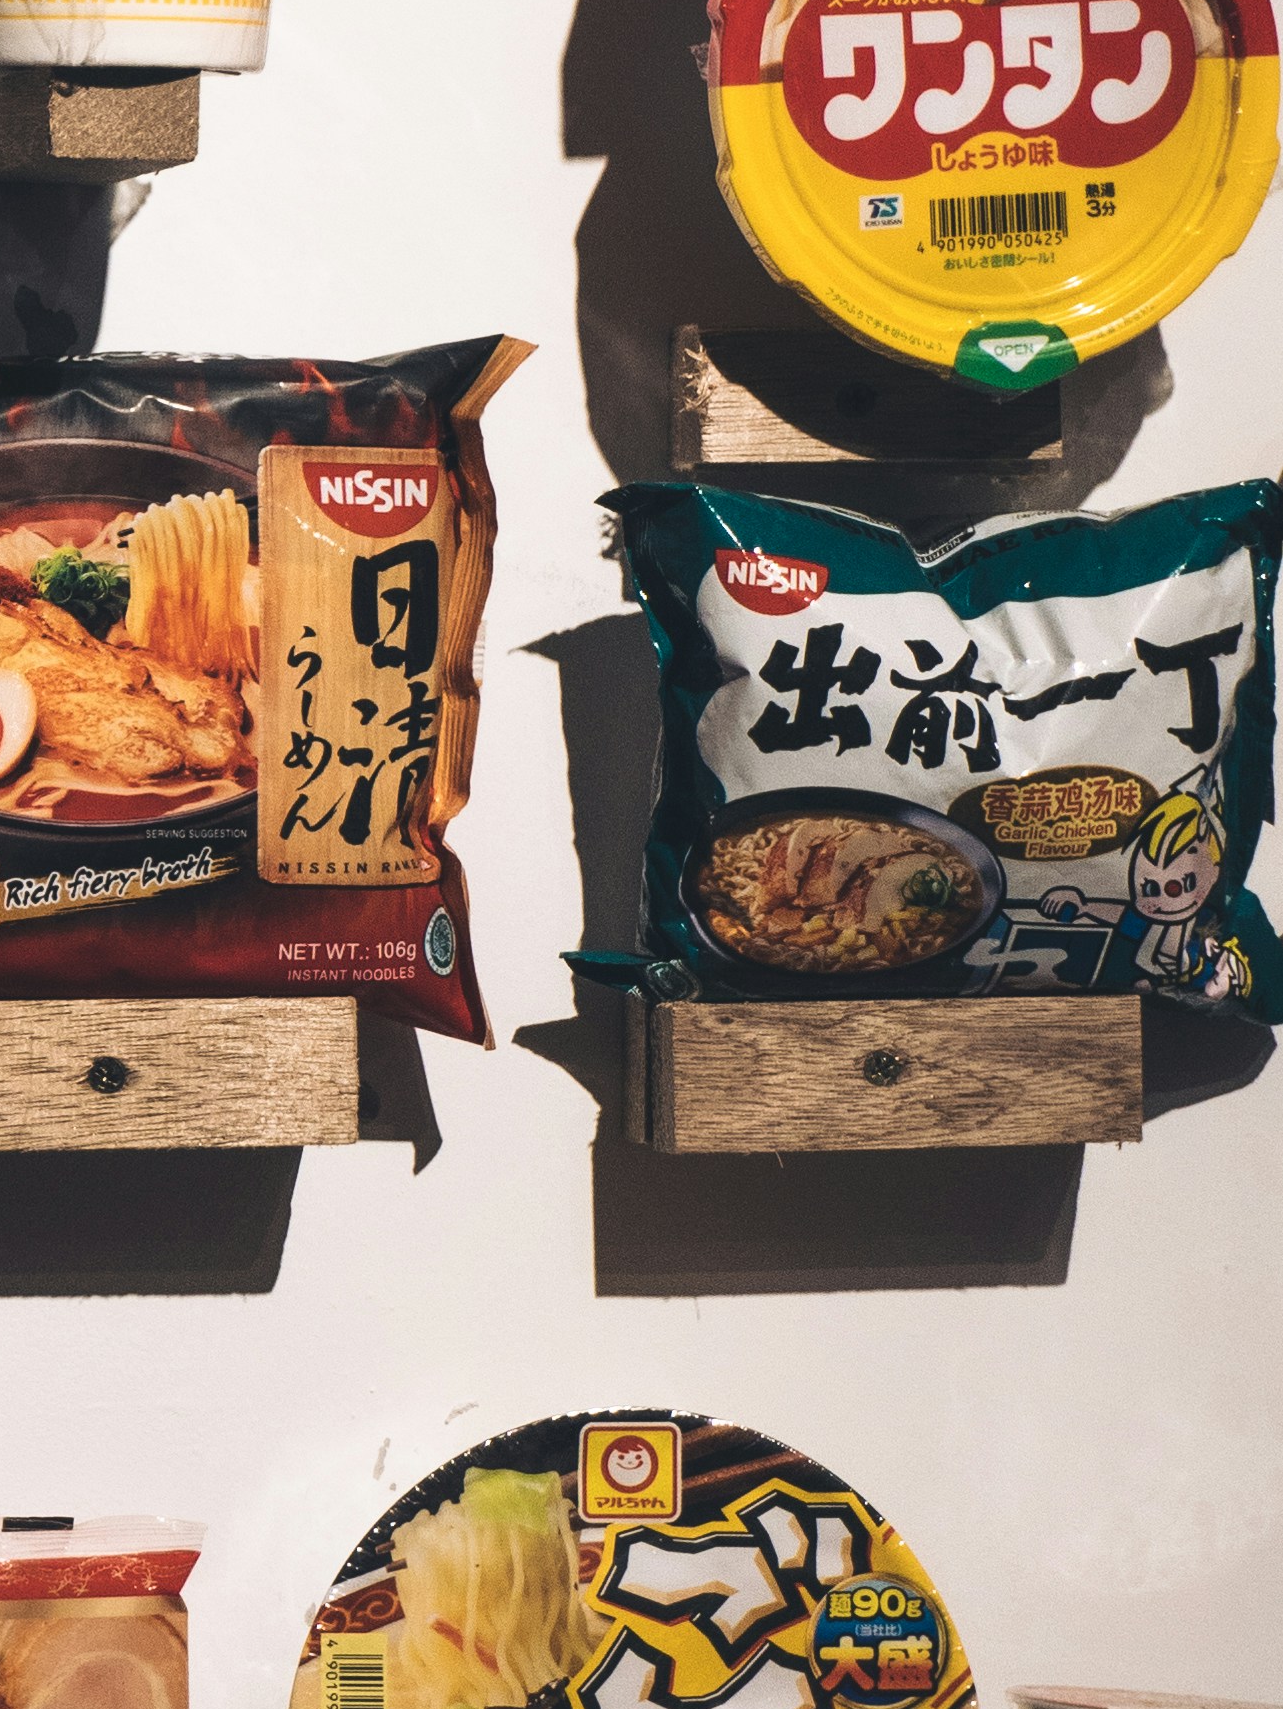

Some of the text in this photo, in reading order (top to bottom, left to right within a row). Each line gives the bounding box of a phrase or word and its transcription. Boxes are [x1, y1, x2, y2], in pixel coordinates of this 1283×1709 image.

[933, 142, 1058, 172] しょうゆ味
[317, 469, 429, 513] NISSIN
[725, 557, 821, 595] NISSIN
[746, 621, 1245, 773] 出前一丁
[994, 819, 1116, 844] Garlic Chicken
[1024, 838, 1090, 859] Flavour
[5, 846, 213, 910] Rich broth
[278, 862, 367, 874] NISSIN
[278, 941, 417, 961] NET 106g
[288, 966, 416, 981] INSTANT NOODLES
[593, 1495, 667, 1511] マルちゃん
[818, 1639, 933, 1692] 大盛
